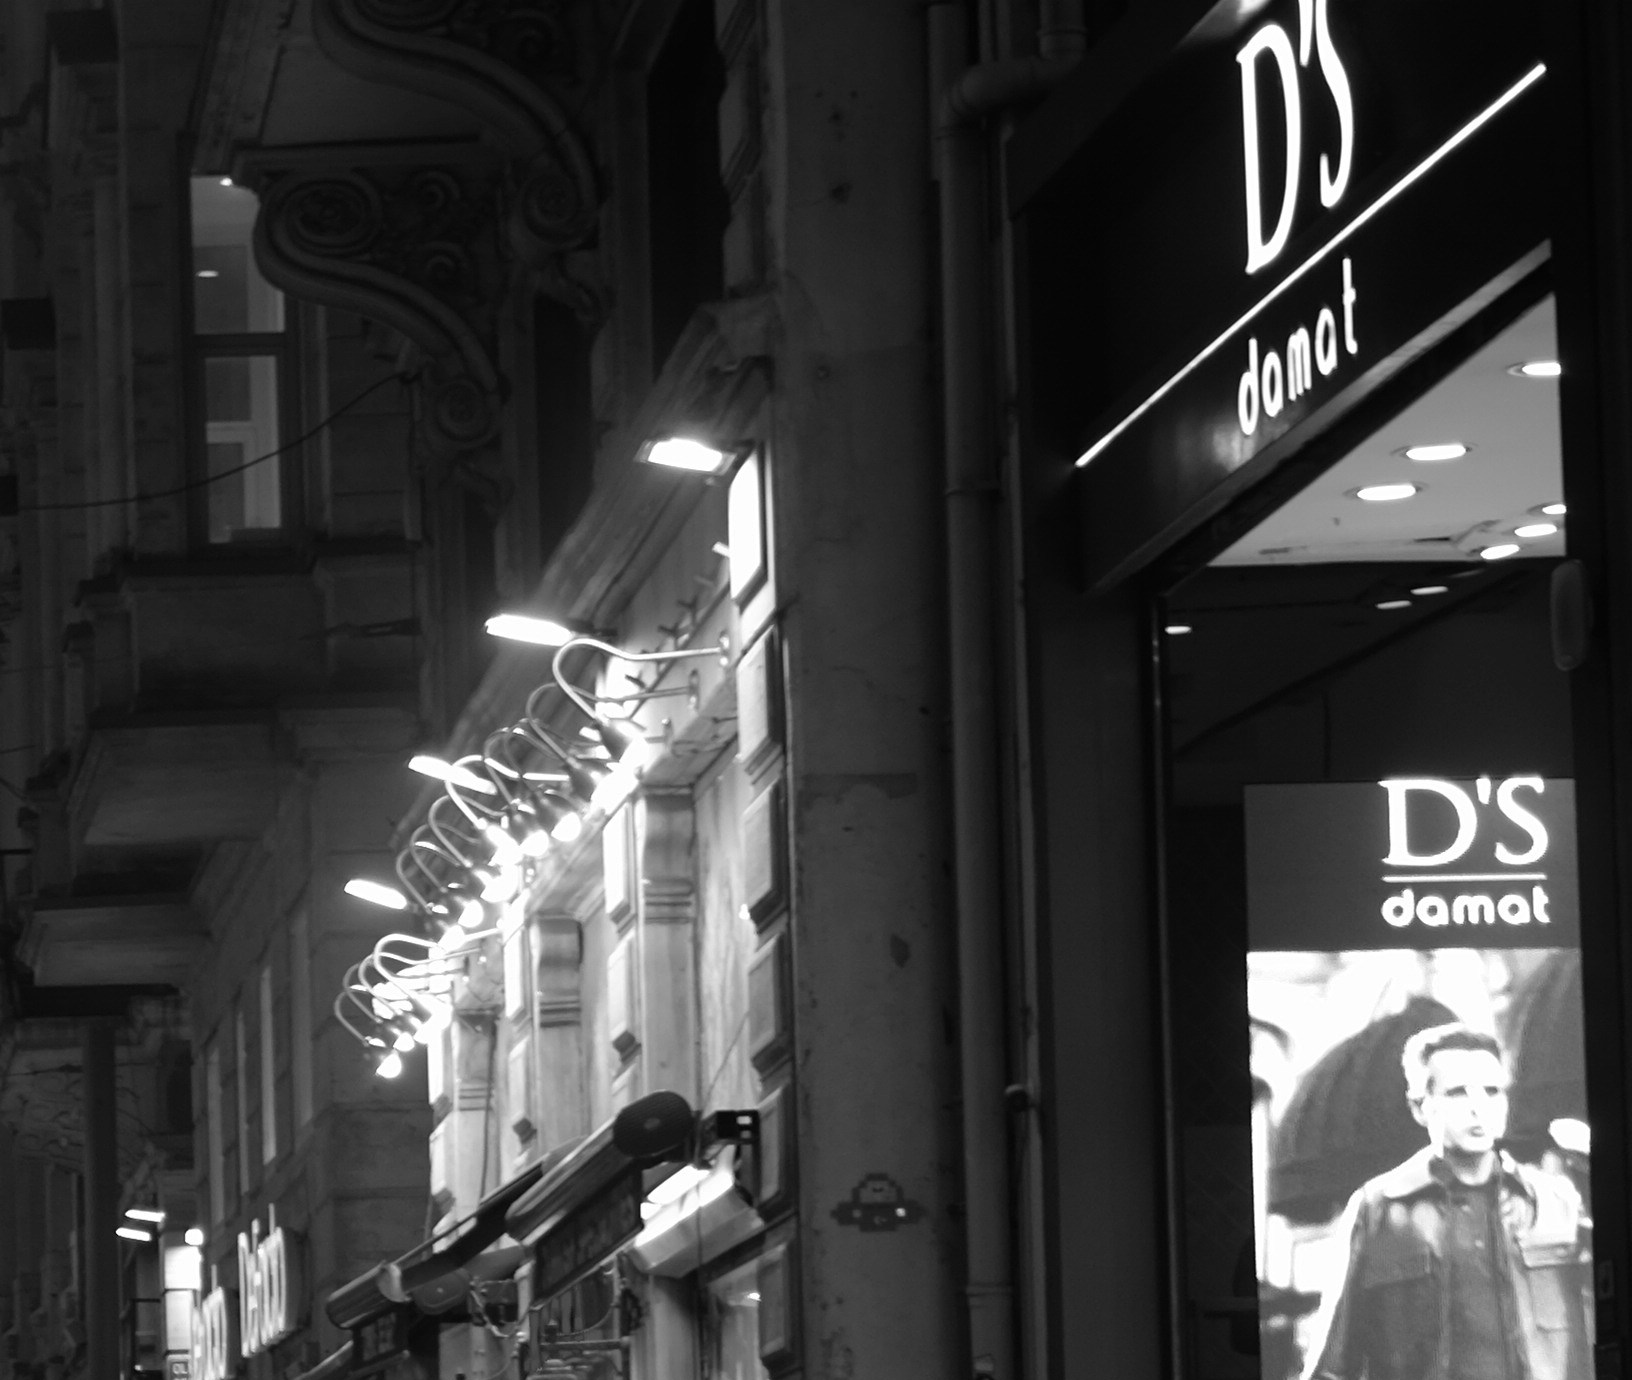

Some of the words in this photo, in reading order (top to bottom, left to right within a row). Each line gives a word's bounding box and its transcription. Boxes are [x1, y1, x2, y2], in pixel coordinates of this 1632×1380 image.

[1236, 0, 1355, 275] D'S
[1237, 257, 1358, 437] damat
[1378, 774, 1549, 867] D'S
[1381, 886, 1551, 928] damat
